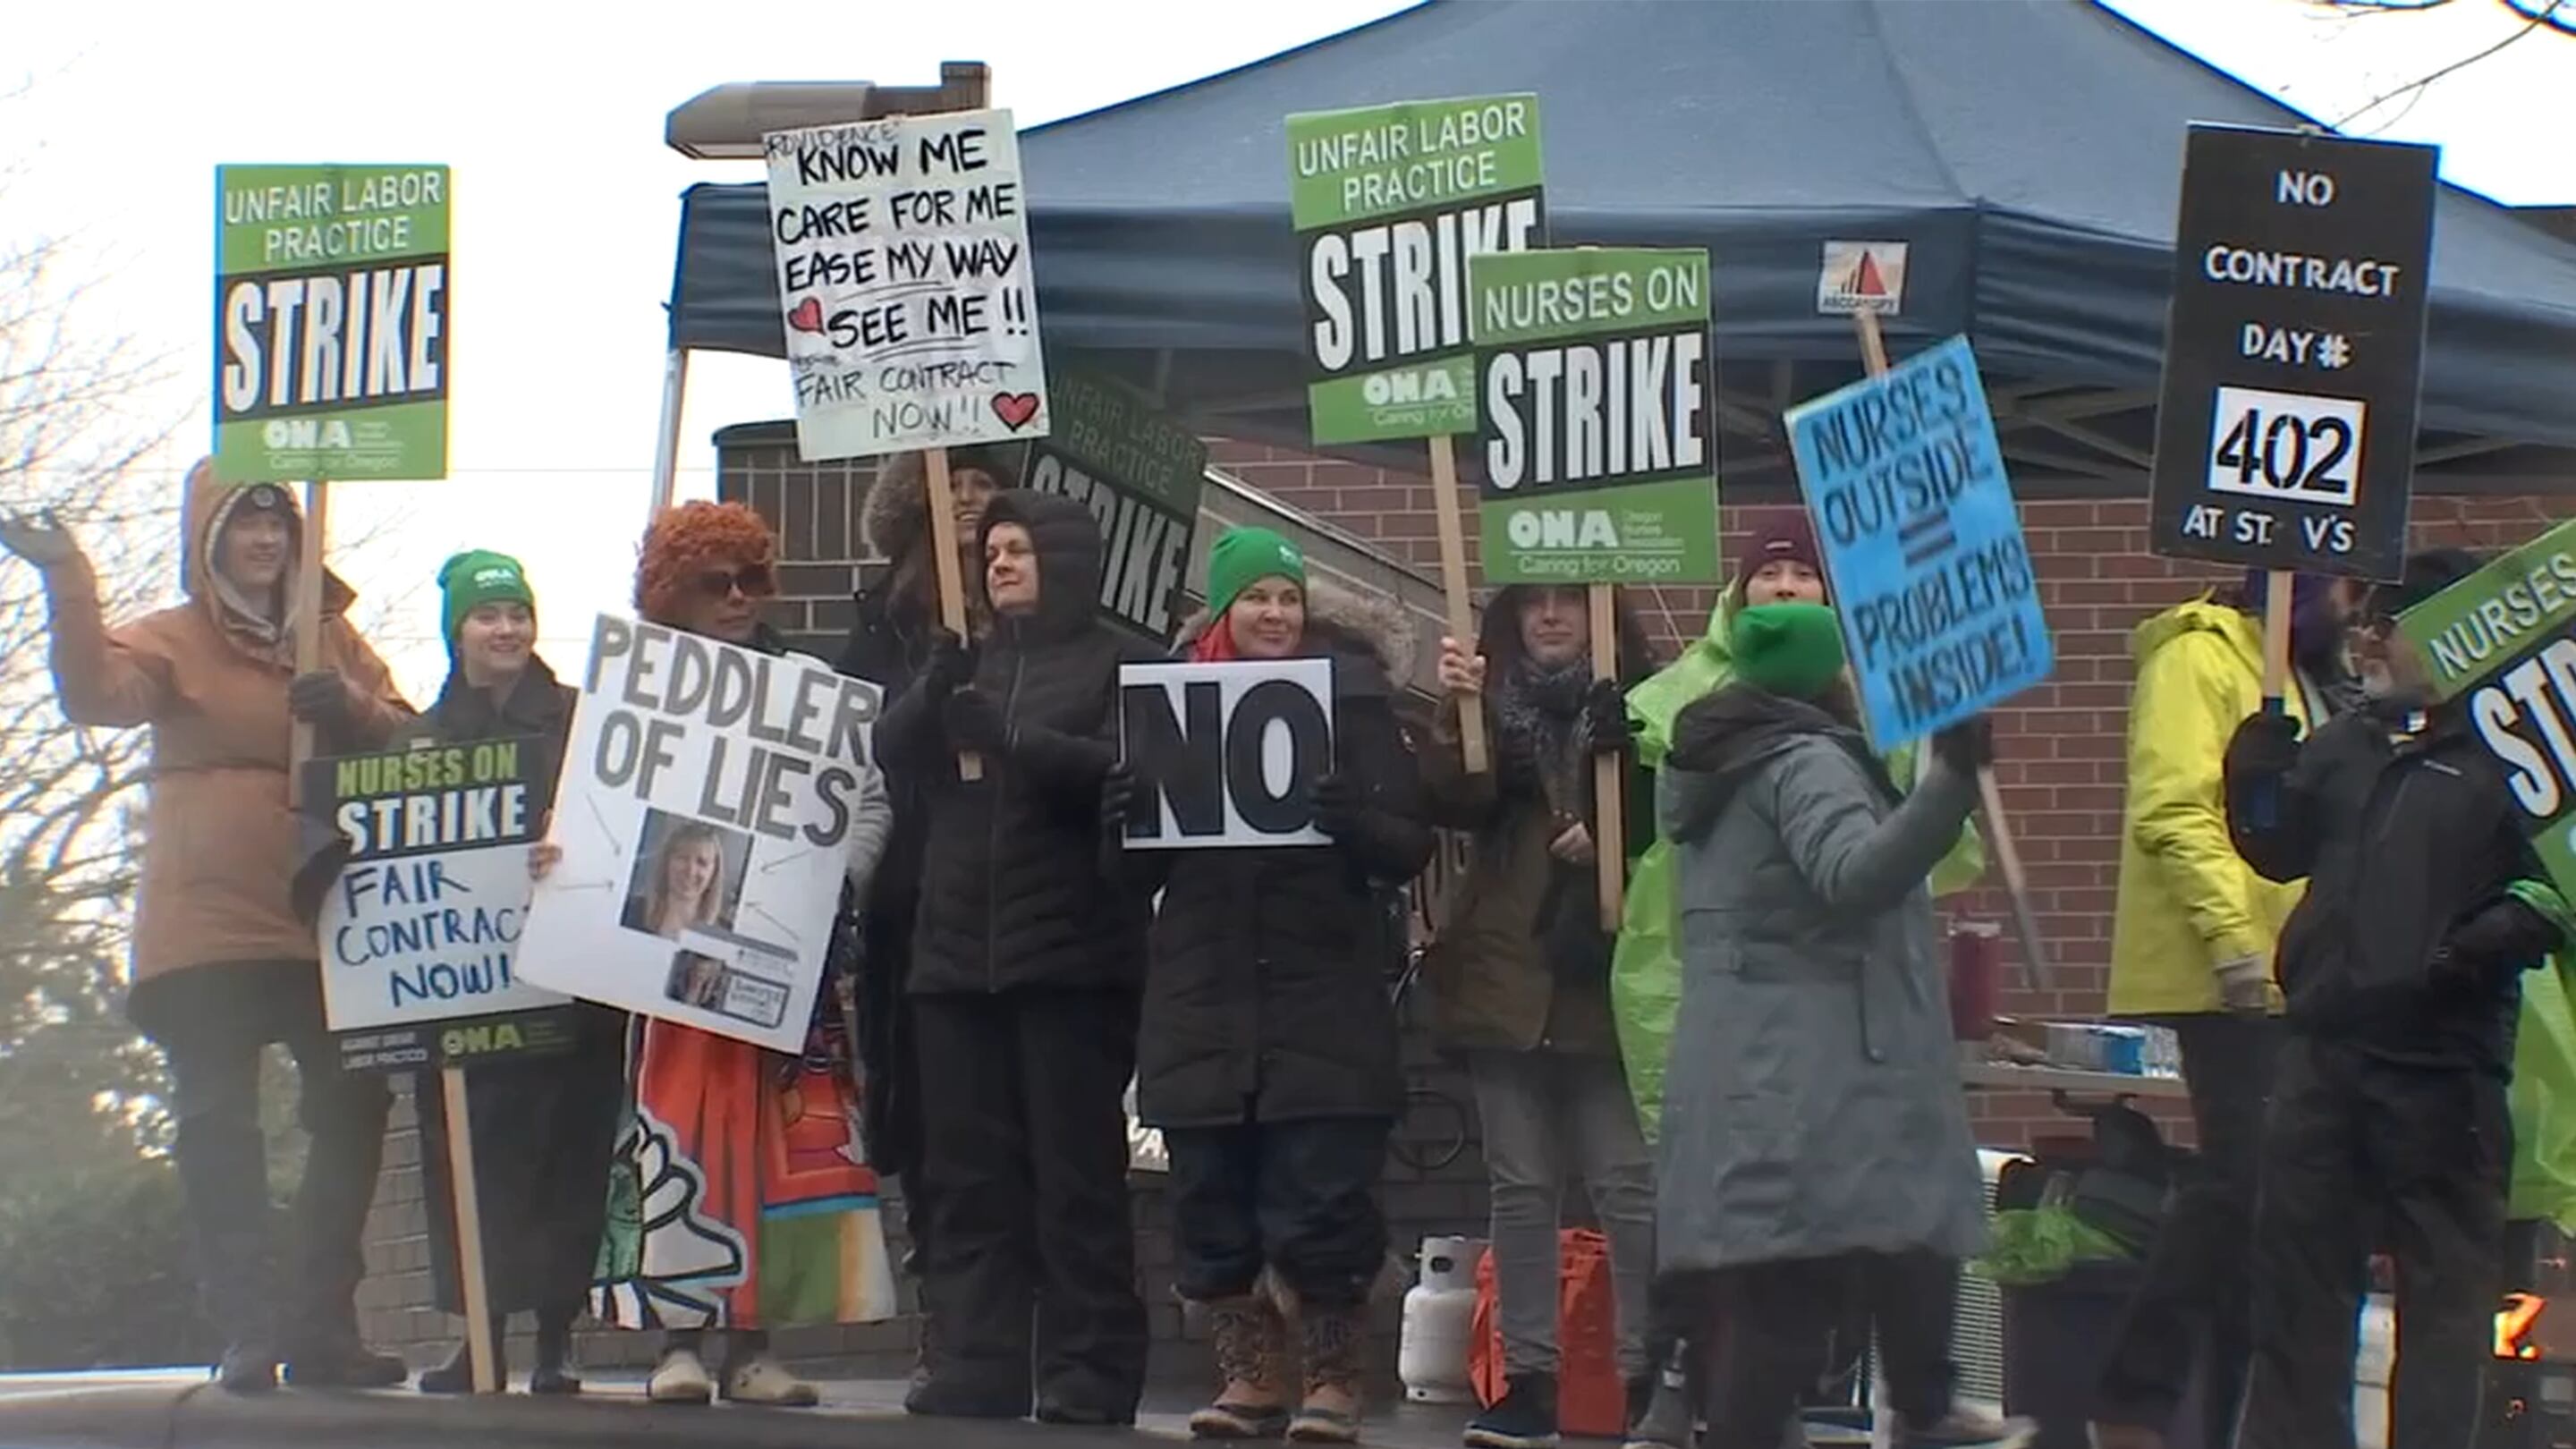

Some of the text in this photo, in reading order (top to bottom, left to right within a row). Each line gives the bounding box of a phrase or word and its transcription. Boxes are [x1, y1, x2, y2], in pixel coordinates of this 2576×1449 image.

[797, 129, 989, 186] KNOW ME
[1298, 100, 1527, 178] UNFAIR LABOR
[225, 170, 442, 225] UNFAIR LABOR
[1343, 150, 1497, 213] PRACTICE
[2277, 170, 2335, 206] NO
[265, 215, 410, 262] PRACTICE
[776, 182, 1017, 246] CARE FOR ME
[785, 238, 1019, 293] EASE MY WAY
[2205, 245, 2401, 297] CONTRACT
[826, 301, 909, 350] SEE
[927, 293, 990, 337] ME
[1485, 265, 1699, 332] NURSES ON
[224, 264, 443, 412] STRIKE
[795, 370, 866, 408] FAIR
[879, 360, 1017, 394] CONTRACT
[1364, 368, 1458, 406] ONA
[1487, 331, 1703, 491] STRIKE
[262, 419, 352, 448] ONA
[1129, 405, 1202, 467] LABOR
[1809, 360, 1969, 481] NURSES
[2216, 408, 2351, 494] 402
[1068, 420, 1174, 496] PRACTICE
[1823, 416, 1994, 547] OUTSIDE
[1508, 509, 1620, 549] ONA
[2183, 504, 2224, 538] AT
[2303, 515, 2356, 554] V'S
[1613, 555, 1682, 578] Oregon
[1852, 538, 2030, 674] PROBLEMS
[585, 615, 881, 767] PEDDLER
[1887, 614, 2036, 730] INSIDE!
[336, 741, 518, 798] NURSES ON
[594, 708, 858, 848] OF LIES
[1123, 678, 1332, 839] NO
[336, 784, 527, 855] STRIKE
[343, 860, 471, 919] FAIR
[335, 903, 531, 967] CONTRAC
[389, 953, 511, 1008] NOW!
